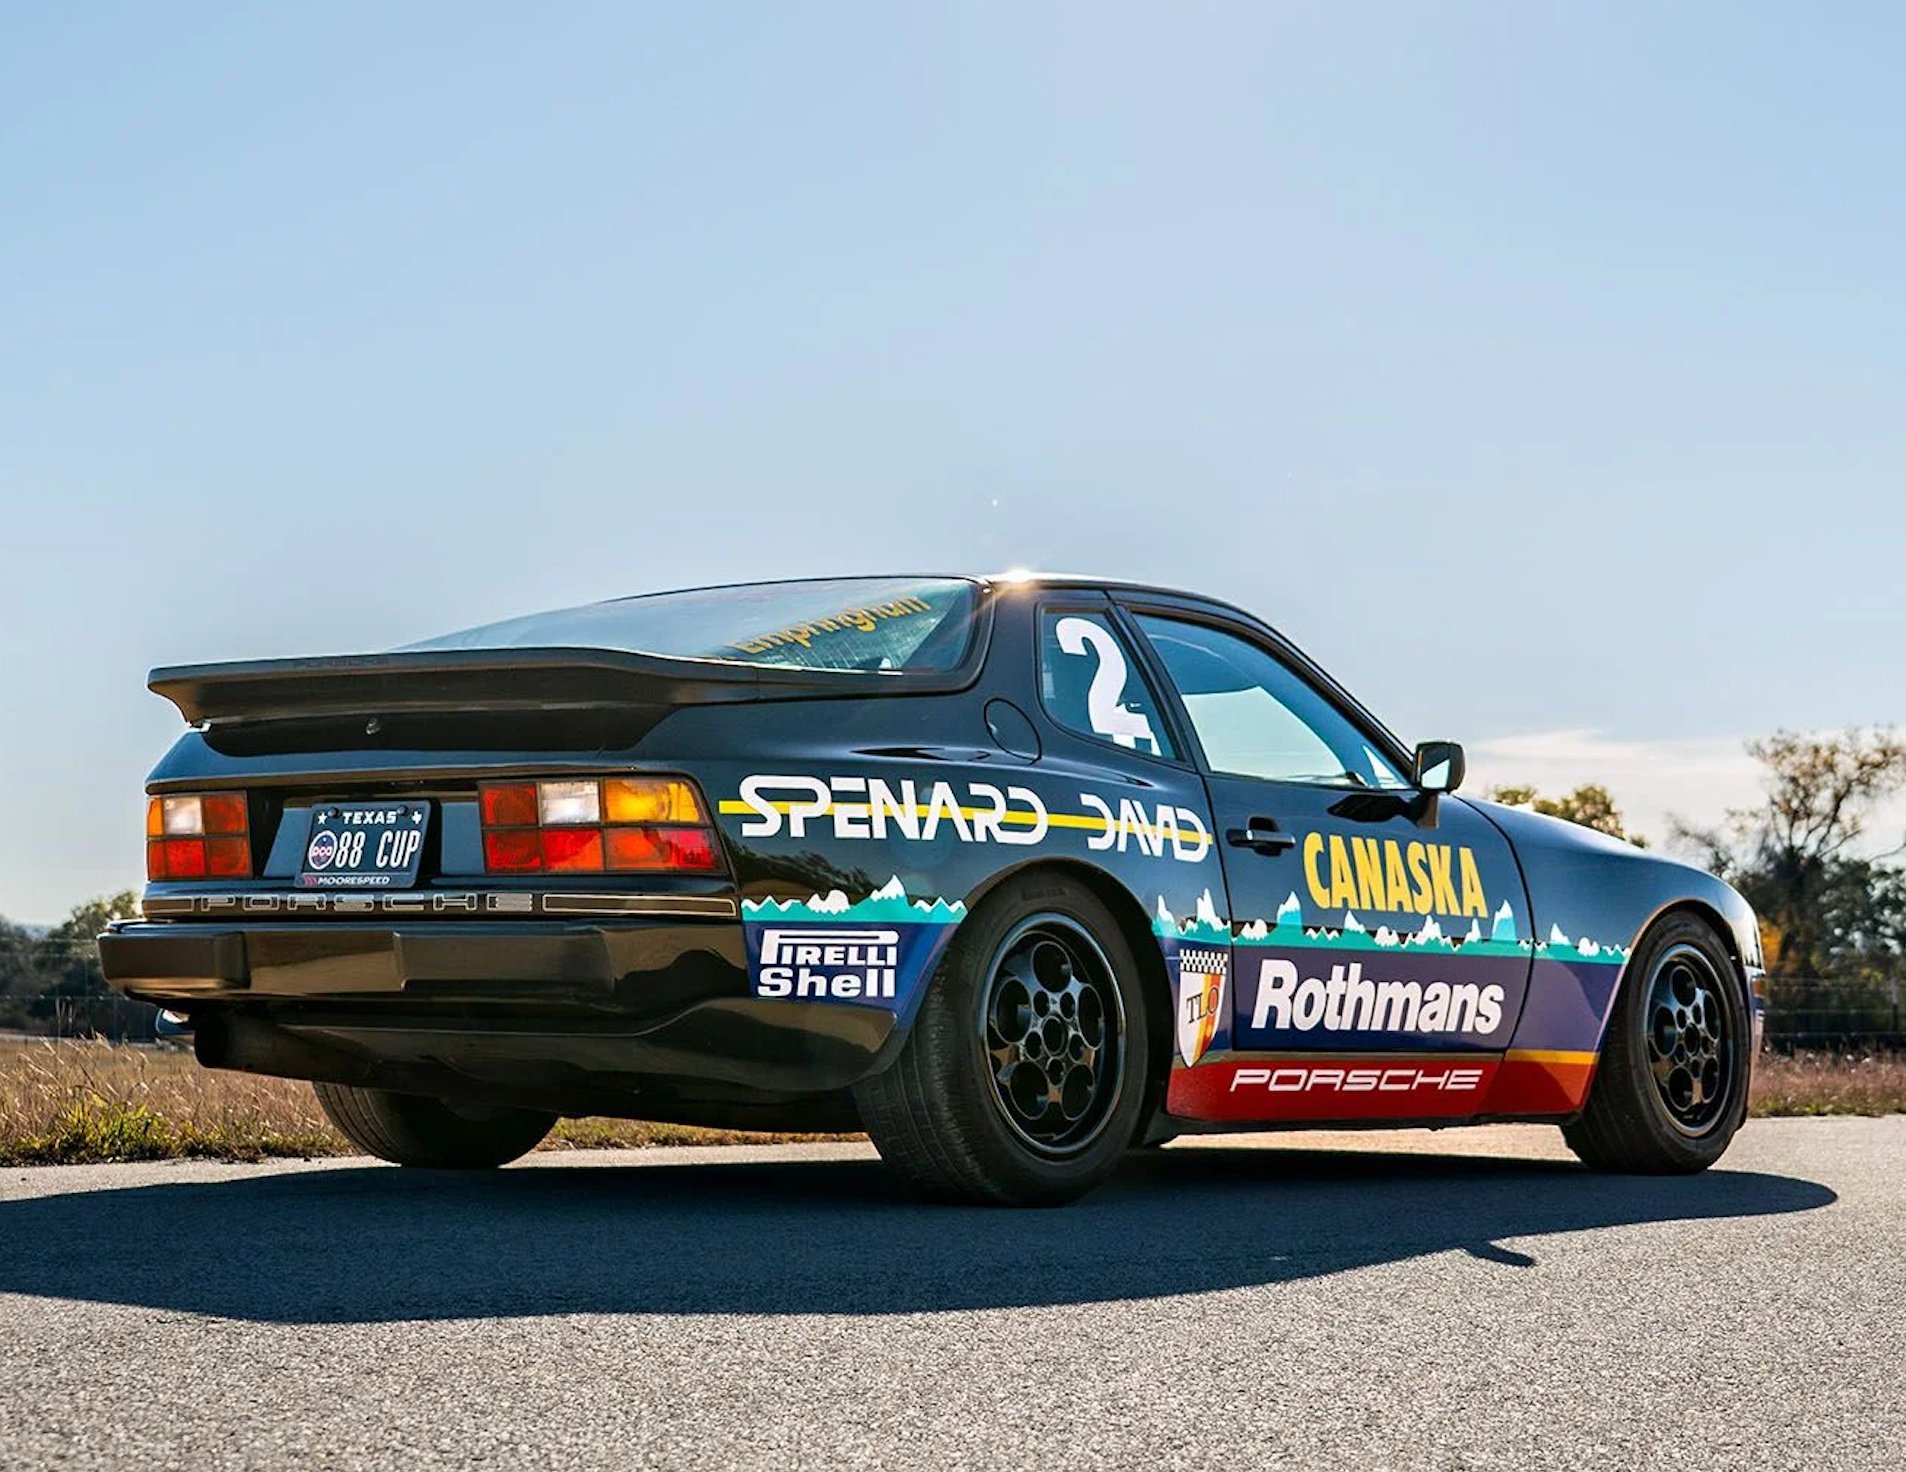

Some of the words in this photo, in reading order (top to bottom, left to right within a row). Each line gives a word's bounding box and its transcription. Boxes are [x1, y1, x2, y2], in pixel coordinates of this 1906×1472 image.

[1055, 617, 1152, 738] 2
[342, 811, 397, 824] TEXAS
[738, 774, 1048, 845] SPENARD
[335, 831, 366, 868] 88
[376, 830, 421, 868] CUP
[317, 876, 391, 886] MOORESPEED
[1304, 832, 1488, 918] CANASKA
[201, 893, 534, 912] PORSCHE
[760, 930, 900, 966] PIRELLI
[757, 967, 896, 997] Shell
[1251, 959, 1505, 1034] Rothmans
[1229, 1069, 1483, 1092] PORSCHE
